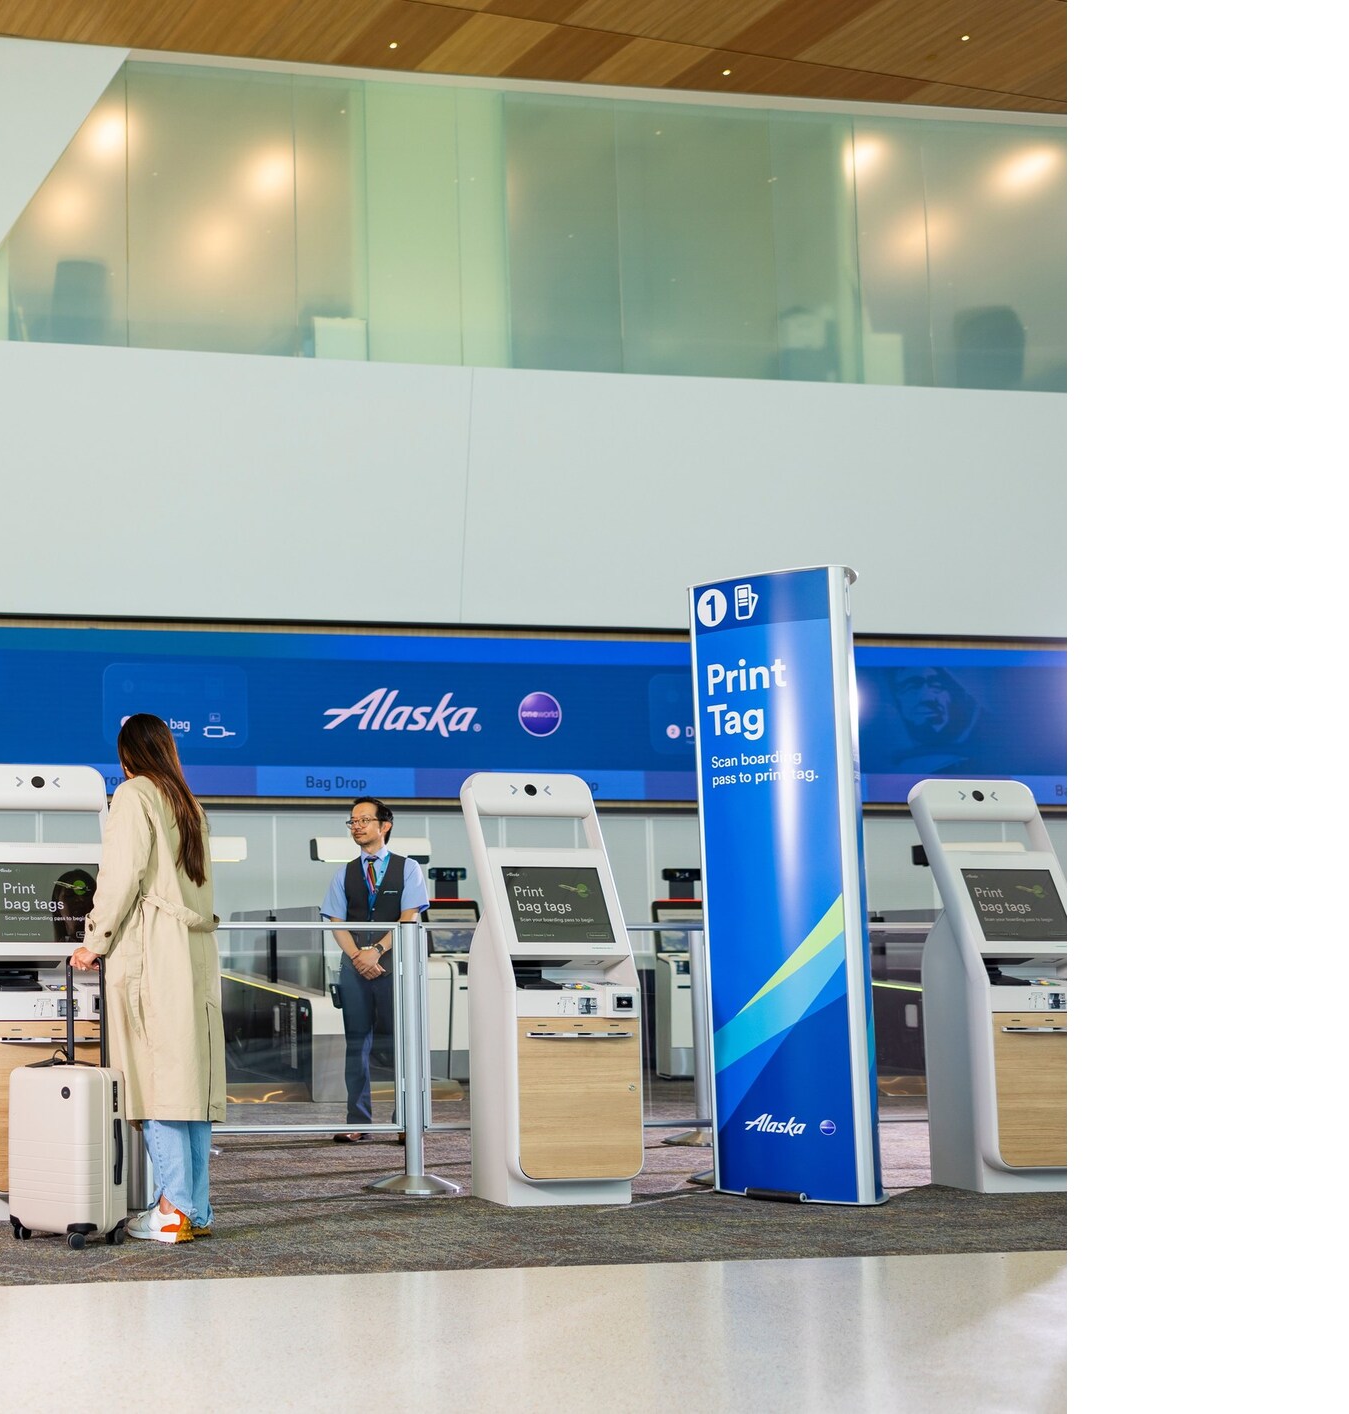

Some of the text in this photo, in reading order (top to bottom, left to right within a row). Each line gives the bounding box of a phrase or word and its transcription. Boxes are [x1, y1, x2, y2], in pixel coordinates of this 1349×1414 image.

[707, 658, 787, 696] Print
[169, 718, 191, 732] bag
[707, 703, 765, 740] Tag
[711, 750, 802, 768] Scan boardig
[306, 776, 367, 792] Bag Drop
[712, 774, 737, 788] pass
[739, 772, 752, 783] to
[755, 768, 786, 785] prin
[2, 882, 36, 895] Print
[513, 886, 545, 897] Print
[974, 887, 1004, 898] Print
[4, 898, 65, 912] bag tags
[516, 900, 572, 914] bag tags
[979, 901, 1032, 914] bag tags
[745, 1113, 807, 1137] Alaska
